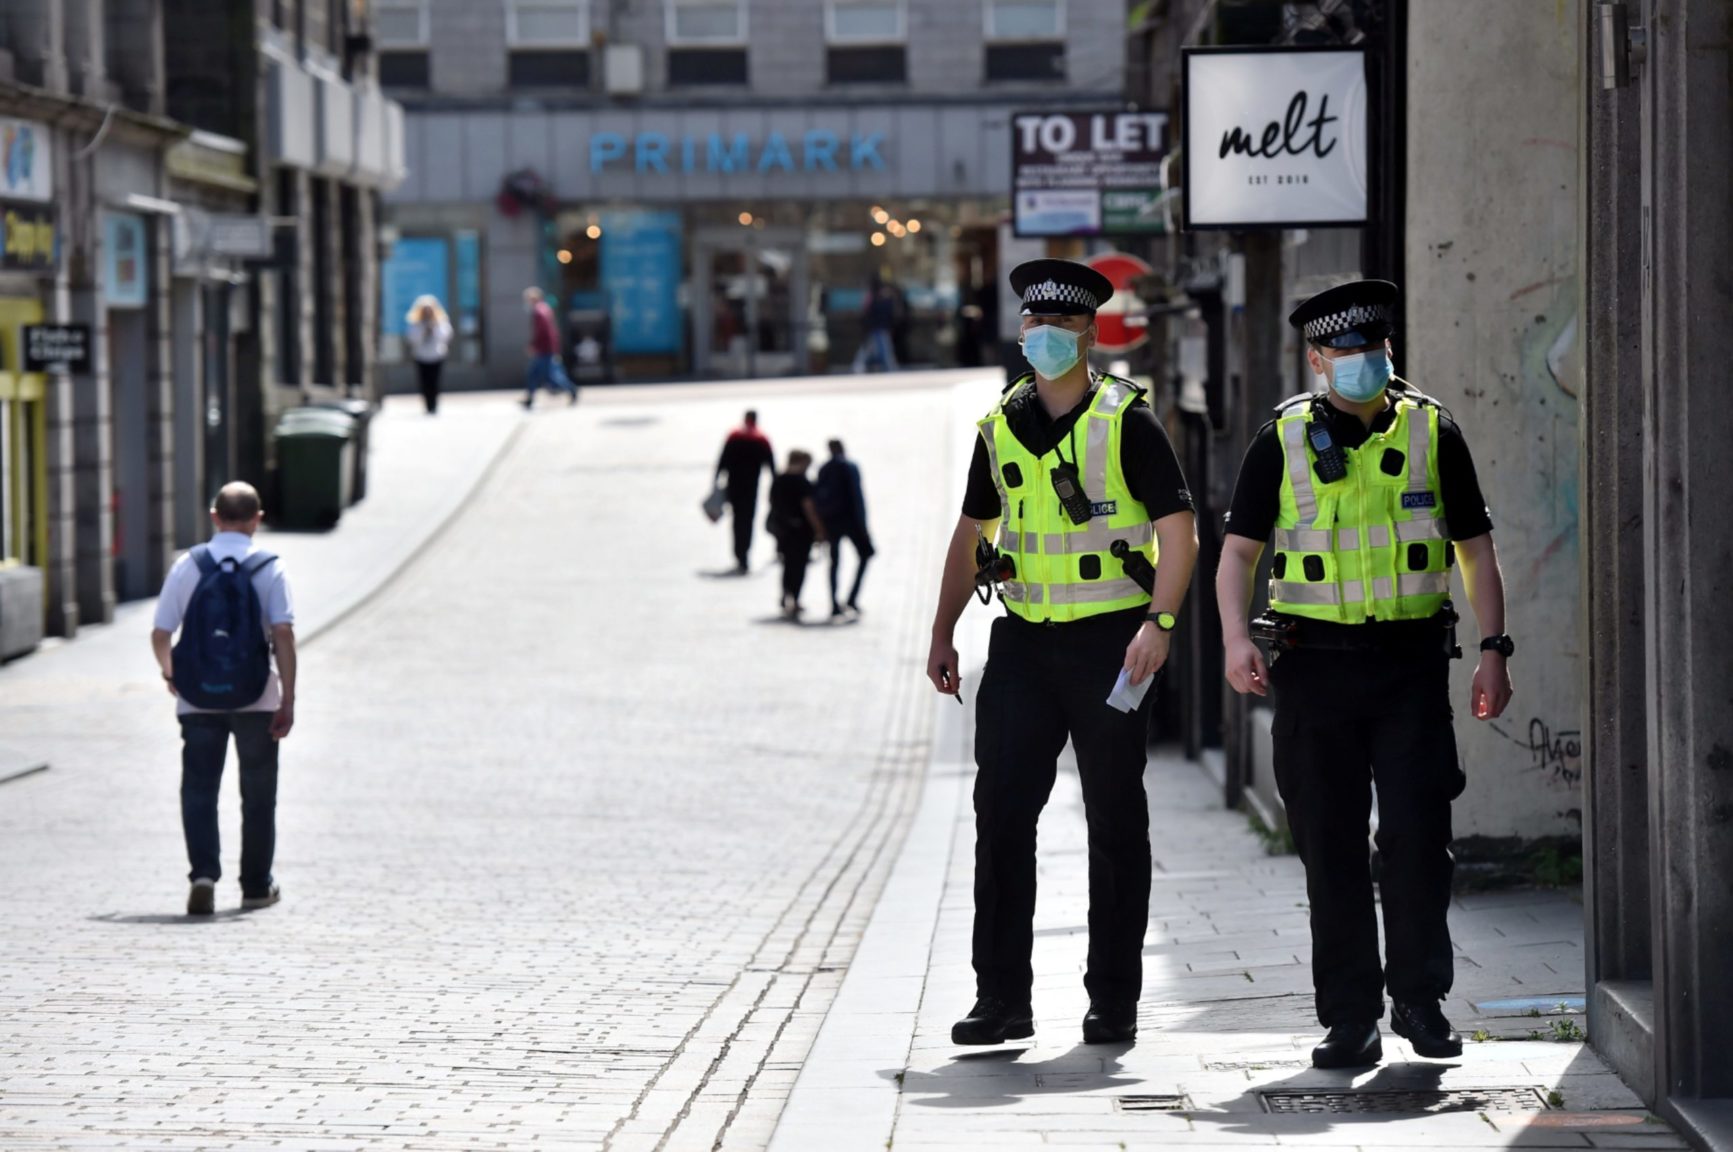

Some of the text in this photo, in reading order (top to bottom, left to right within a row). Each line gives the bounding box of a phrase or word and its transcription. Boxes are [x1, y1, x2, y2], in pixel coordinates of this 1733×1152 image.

[1016, 112, 1168, 153] TO LET
[1219, 90, 1338, 159] melt
[589, 131, 888, 173] PRIMARK
[1090, 503, 1115, 515] LICE
[1403, 493, 1434, 507] POLICE
